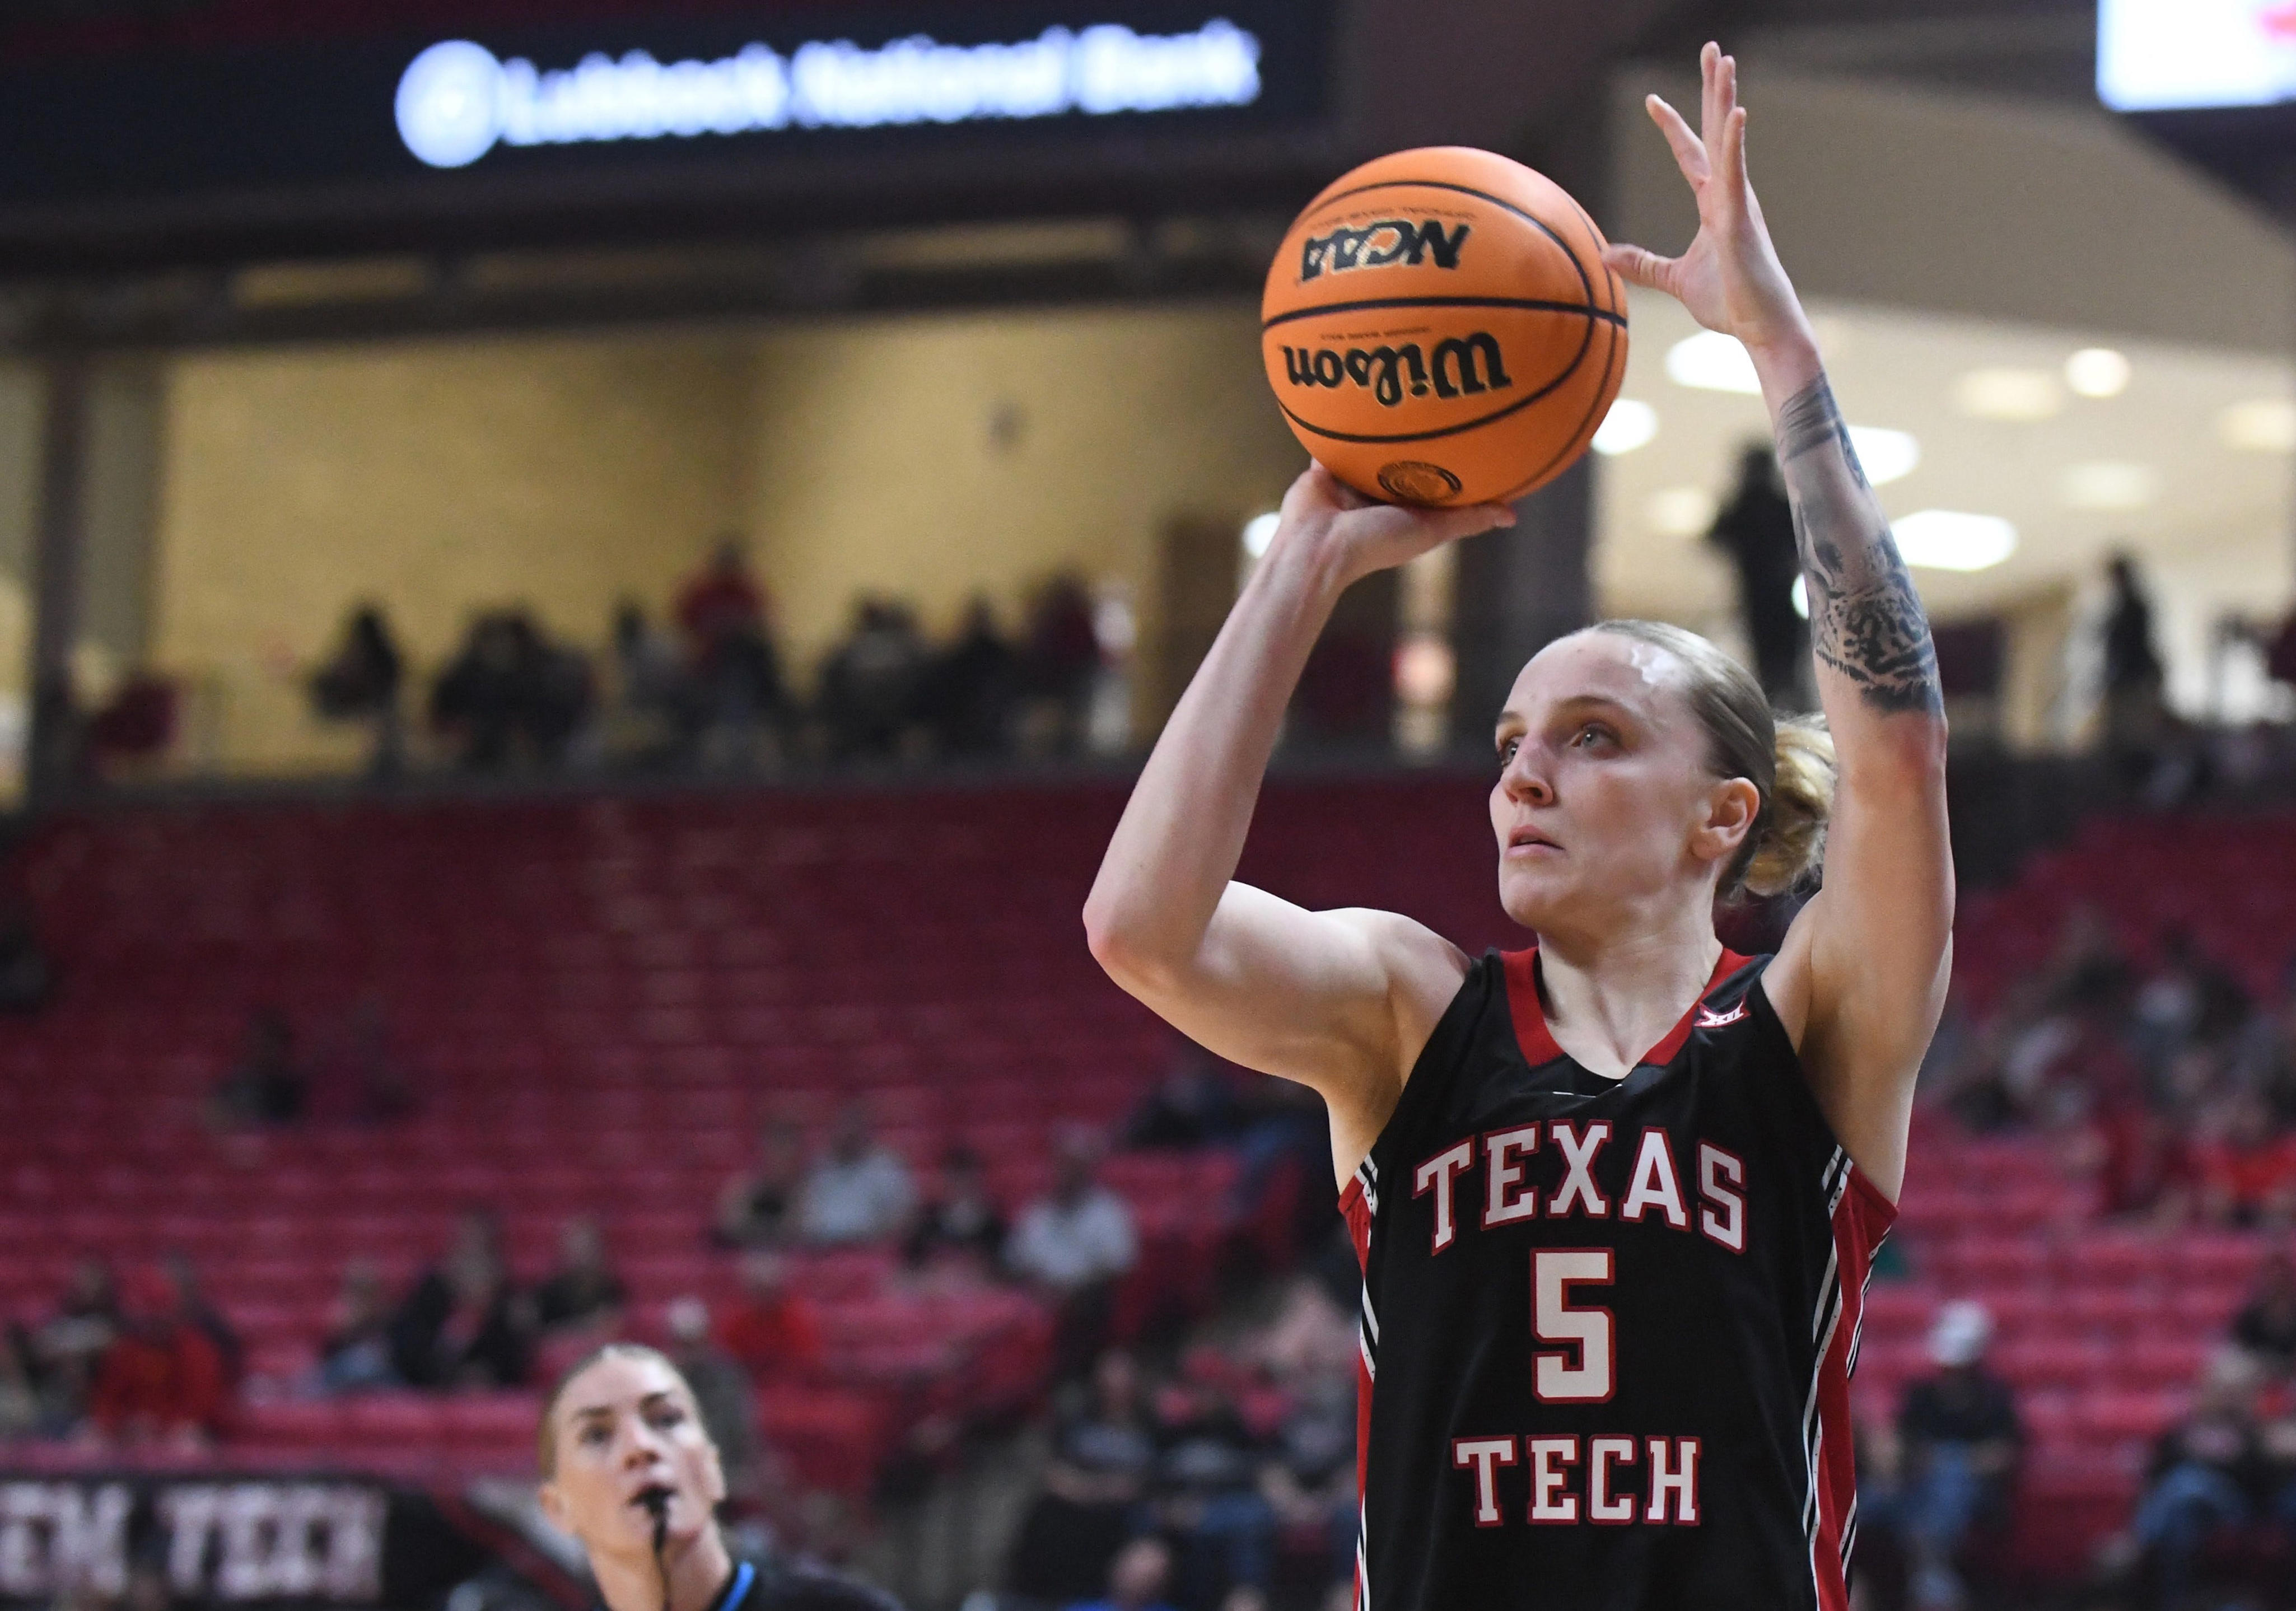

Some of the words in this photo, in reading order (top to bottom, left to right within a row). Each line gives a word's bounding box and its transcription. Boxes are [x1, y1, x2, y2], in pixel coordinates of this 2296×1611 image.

[1299, 220, 1471, 283] NCAA
[1281, 331, 1512, 407] Wilson
[1412, 1119, 1747, 1256] TEXAS
[1529, 1247, 1616, 1404] 5
[1452, 1433, 1701, 1528] TECH
